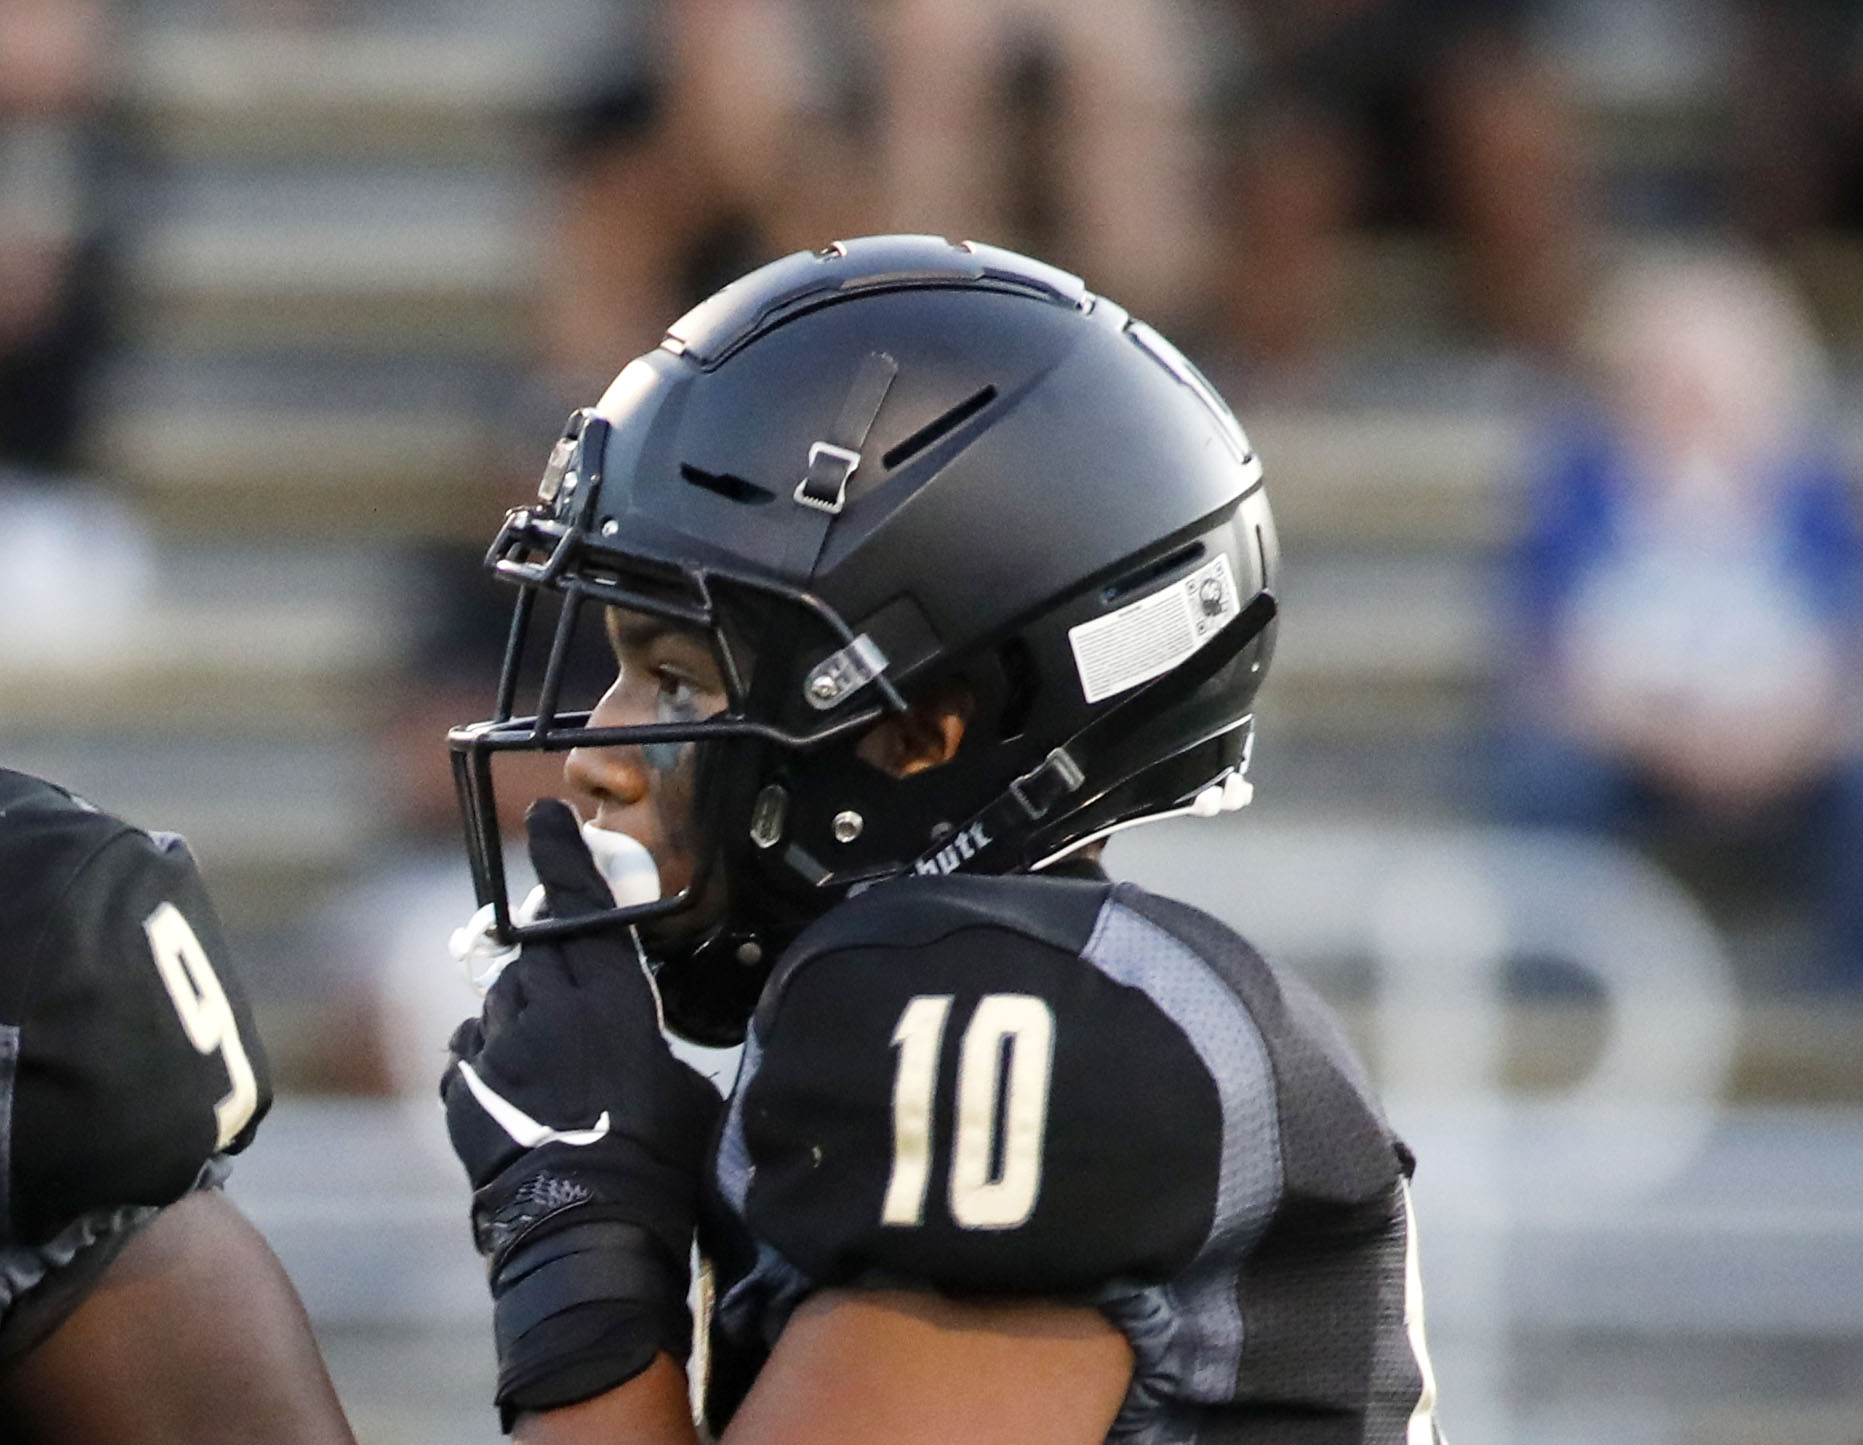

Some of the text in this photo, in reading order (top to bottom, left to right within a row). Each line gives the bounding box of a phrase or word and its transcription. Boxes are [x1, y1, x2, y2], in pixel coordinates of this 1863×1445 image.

[909, 821, 993, 876] hutt
[142, 901, 258, 1151] 9
[880, 992, 1058, 1230] 10
